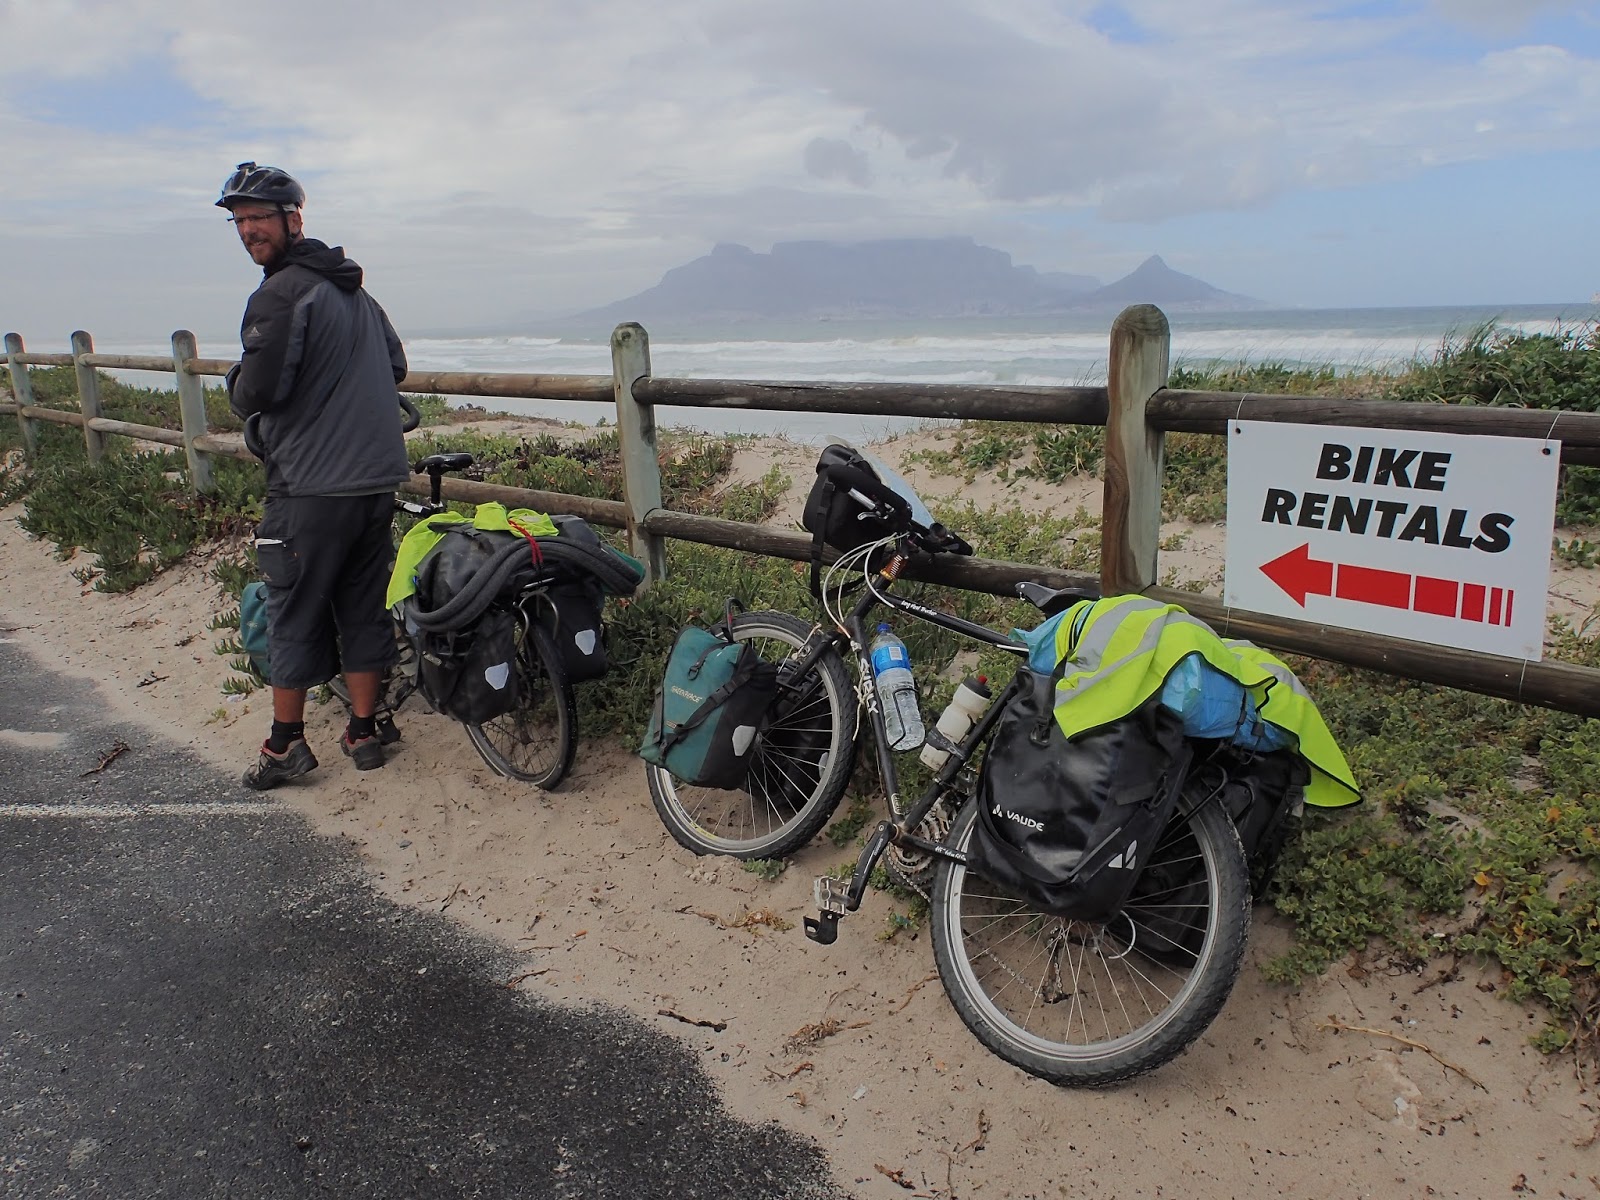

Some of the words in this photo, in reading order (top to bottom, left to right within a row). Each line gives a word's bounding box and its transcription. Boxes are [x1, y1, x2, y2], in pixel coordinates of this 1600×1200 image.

[1315, 443, 1452, 492] BIKE
[1261, 488, 1515, 553] RENTALS
[1006, 810, 1045, 832] VAUDE
